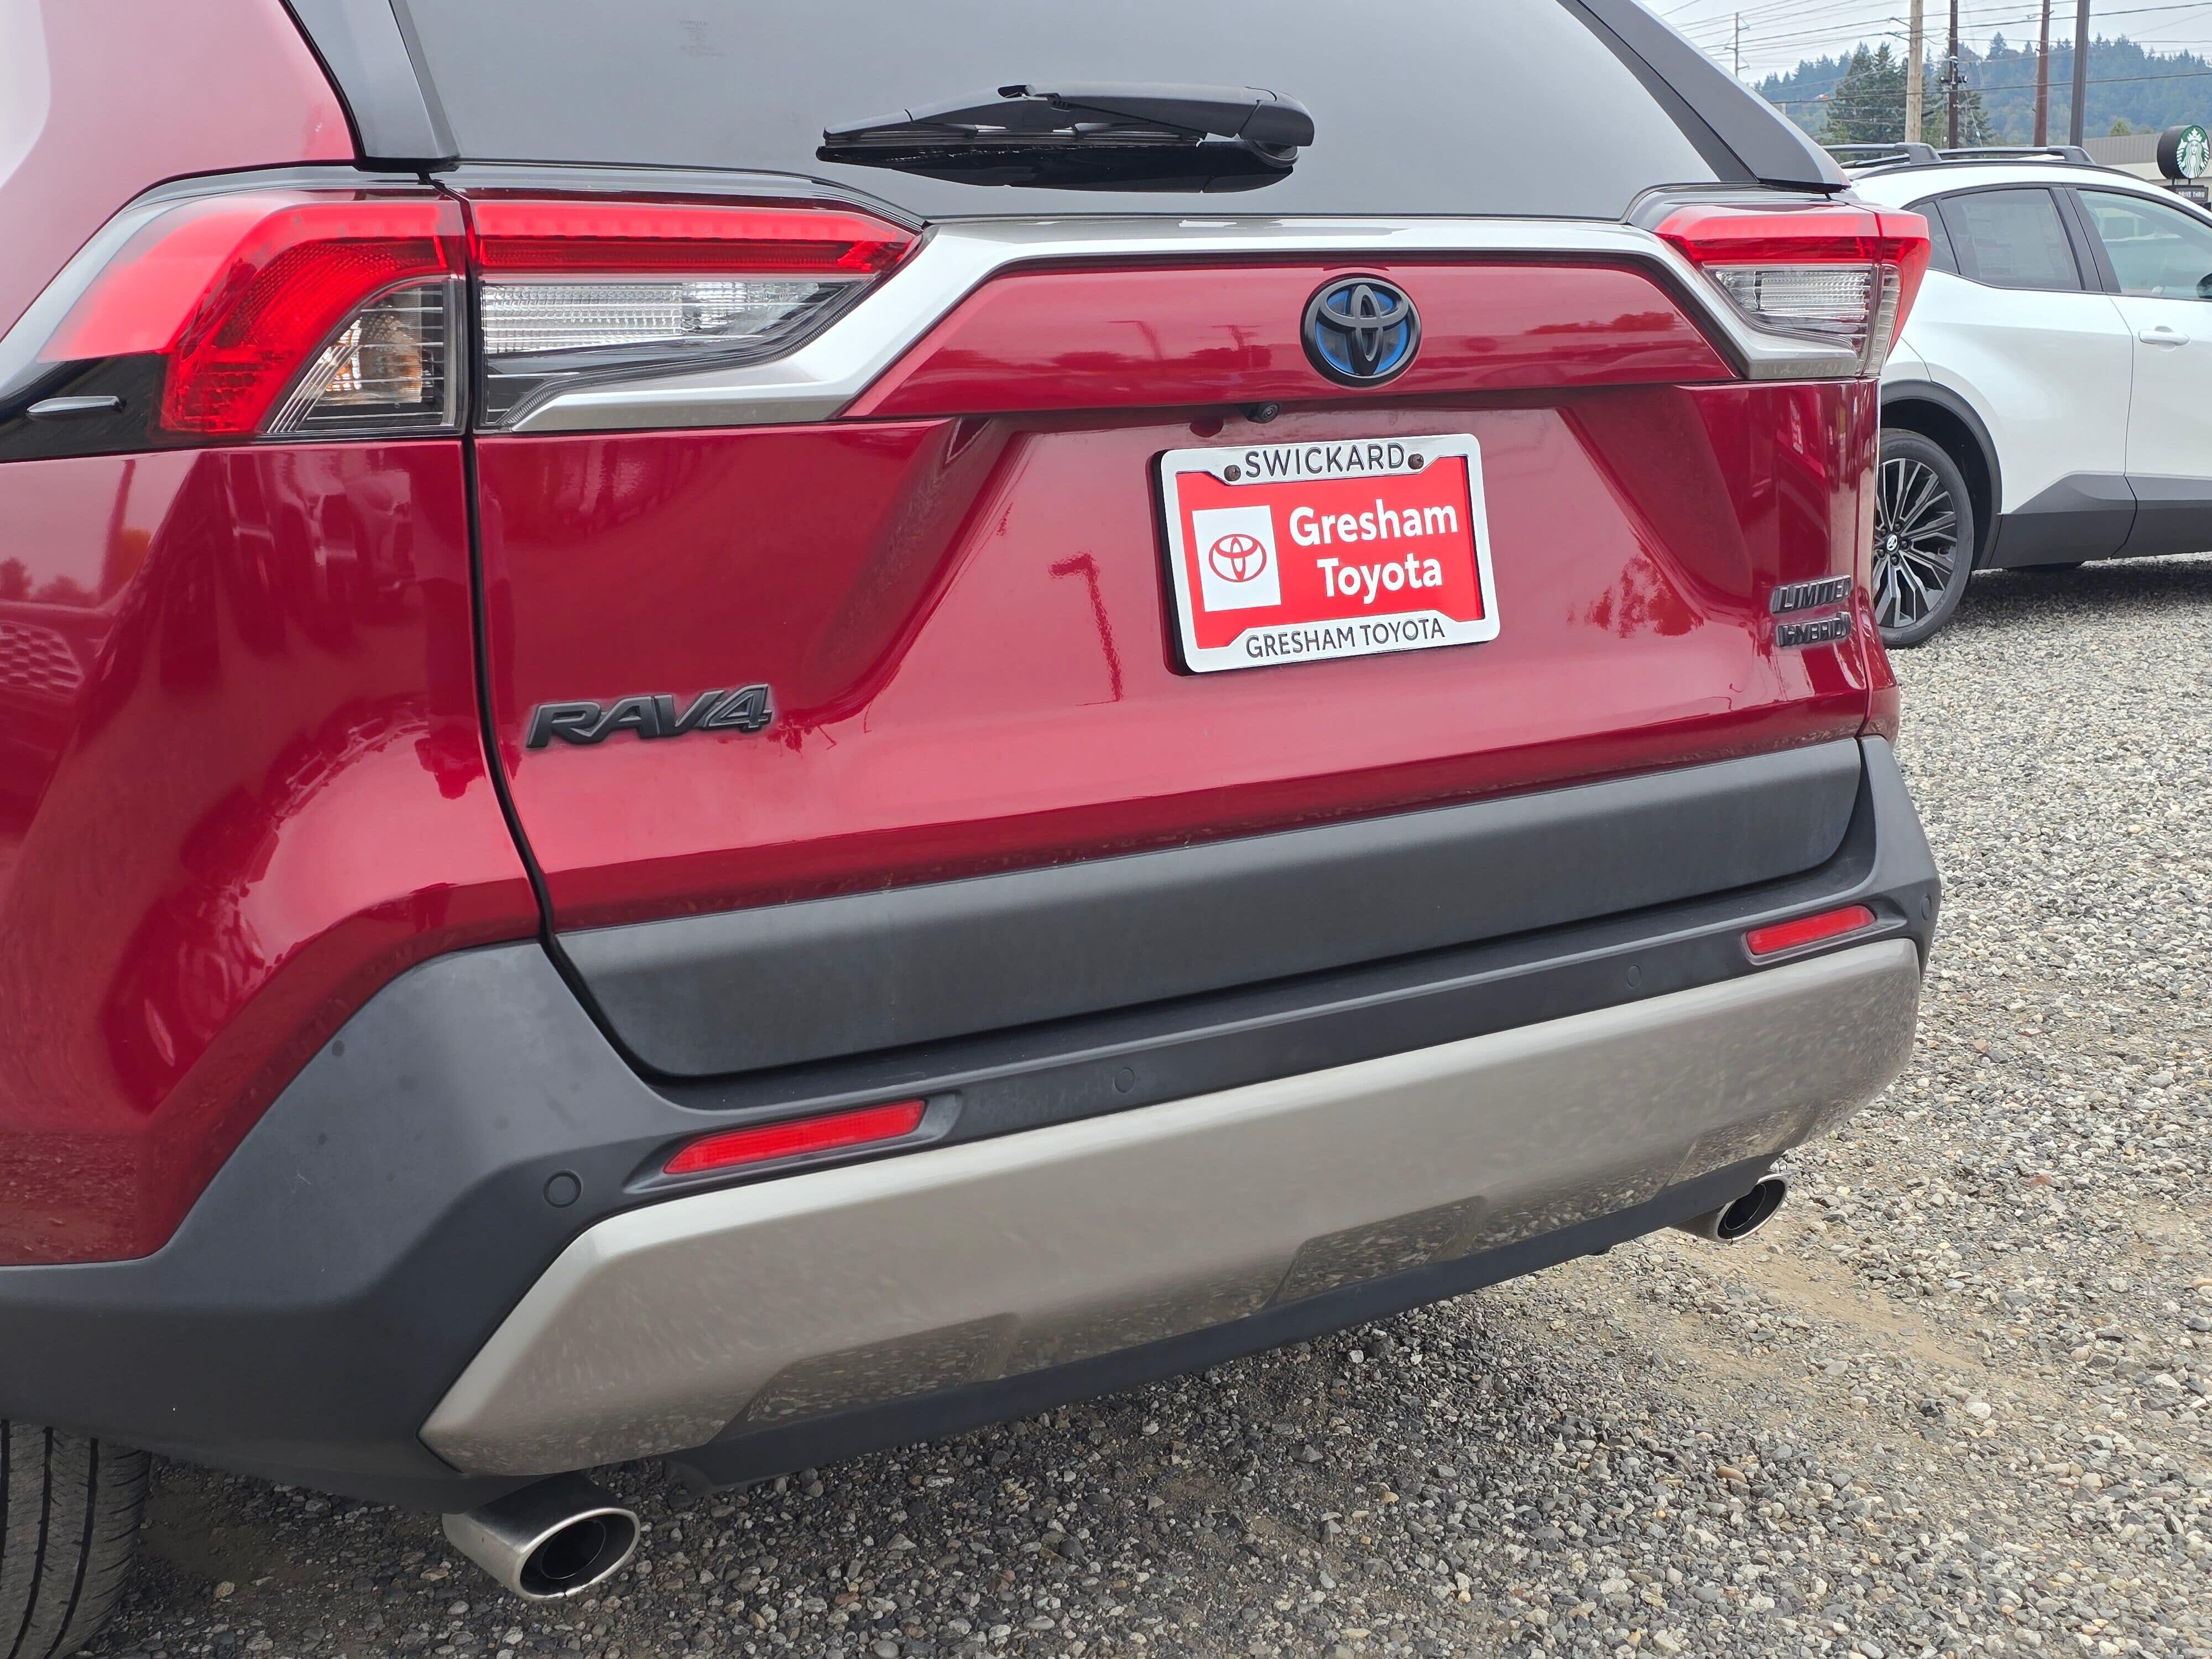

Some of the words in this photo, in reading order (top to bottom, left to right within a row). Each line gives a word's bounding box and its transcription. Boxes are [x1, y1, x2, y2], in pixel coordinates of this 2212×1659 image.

[1245, 443, 1405, 477] SWICKARD
[1290, 499, 1458, 547] Gresham
[1317, 552, 1443, 604] Toyota
[1246, 627, 1355, 659] GRESHAM
[1360, 618, 1446, 646] TOYOTA
[526, 684, 773, 749] RAV4
